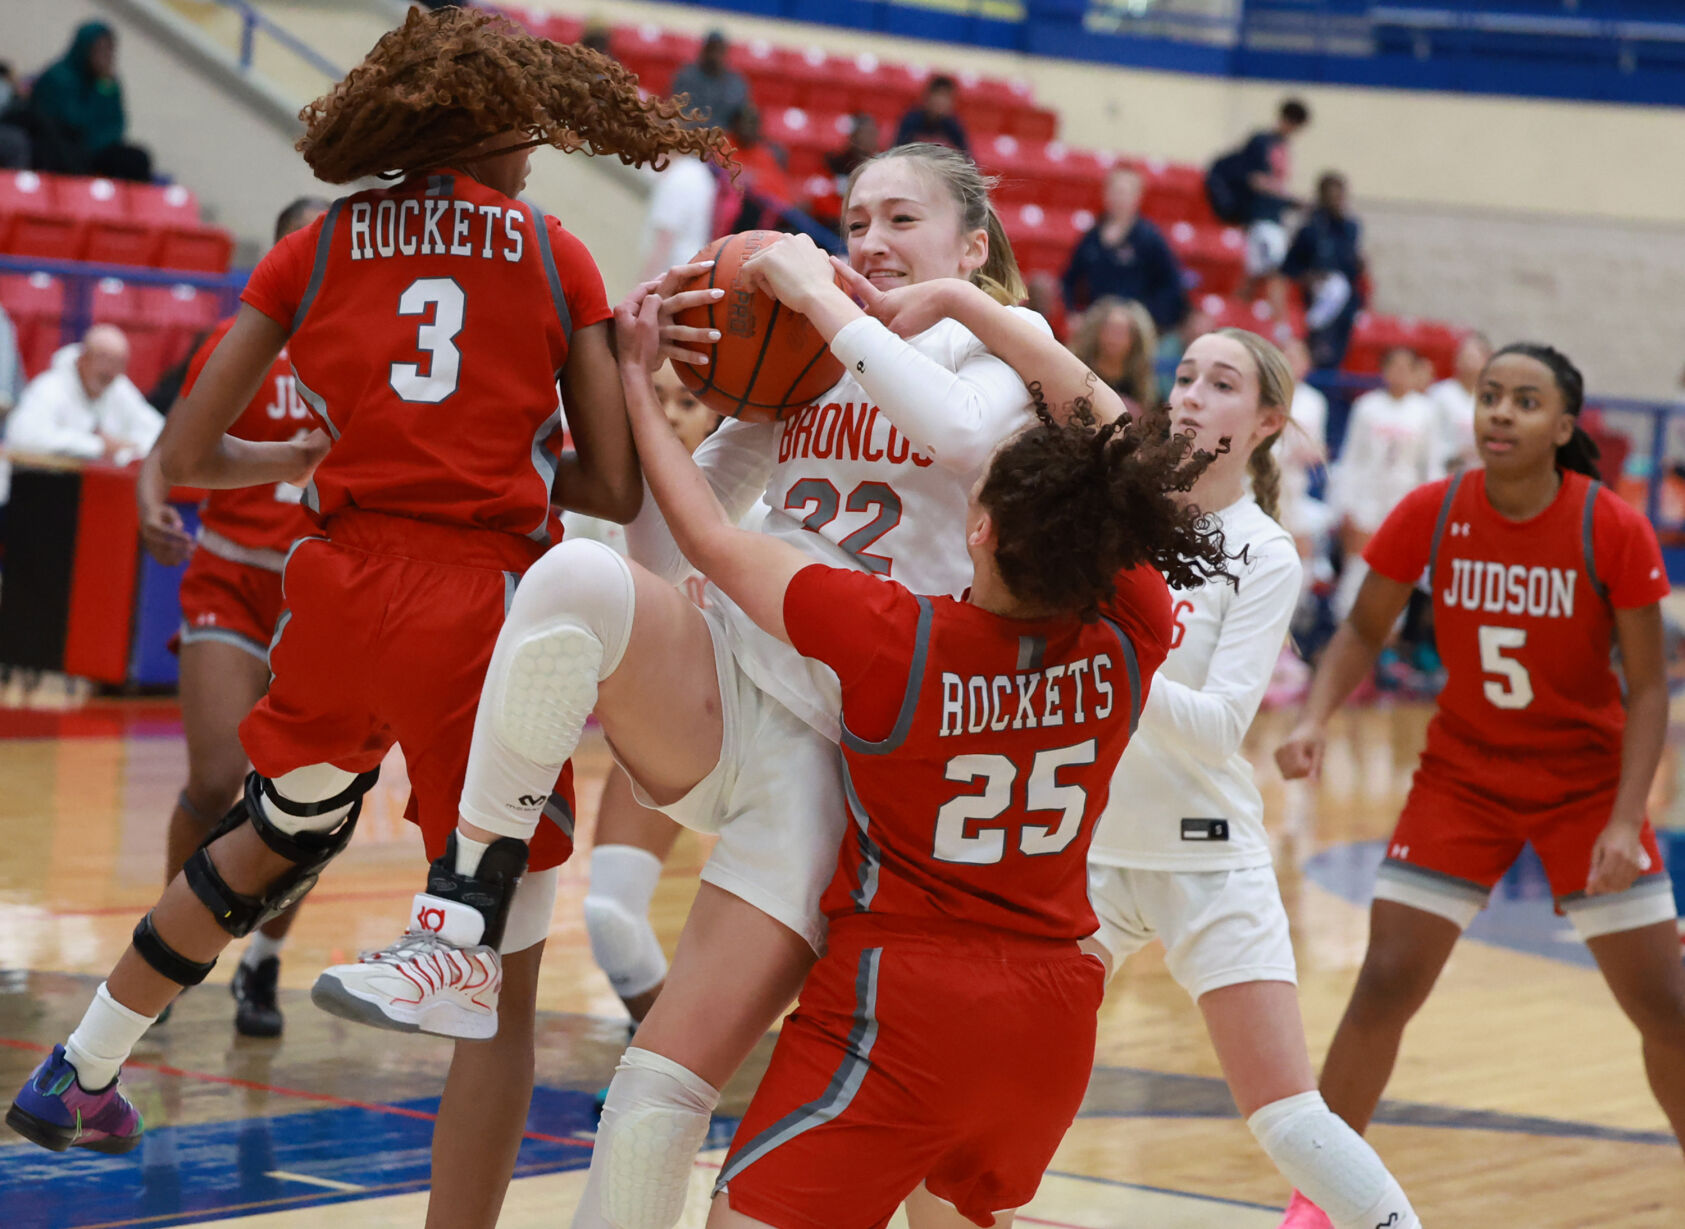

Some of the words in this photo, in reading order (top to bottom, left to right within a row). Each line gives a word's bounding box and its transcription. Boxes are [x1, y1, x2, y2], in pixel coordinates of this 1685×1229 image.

[351, 199, 525, 263] ROCKETS
[388, 276, 467, 404] 3
[784, 477, 903, 577] 22
[1443, 558, 1578, 619] JUDSON
[939, 653, 1113, 737] ROCKETS
[1478, 625, 1534, 710] 5
[932, 737, 1098, 864] 25
